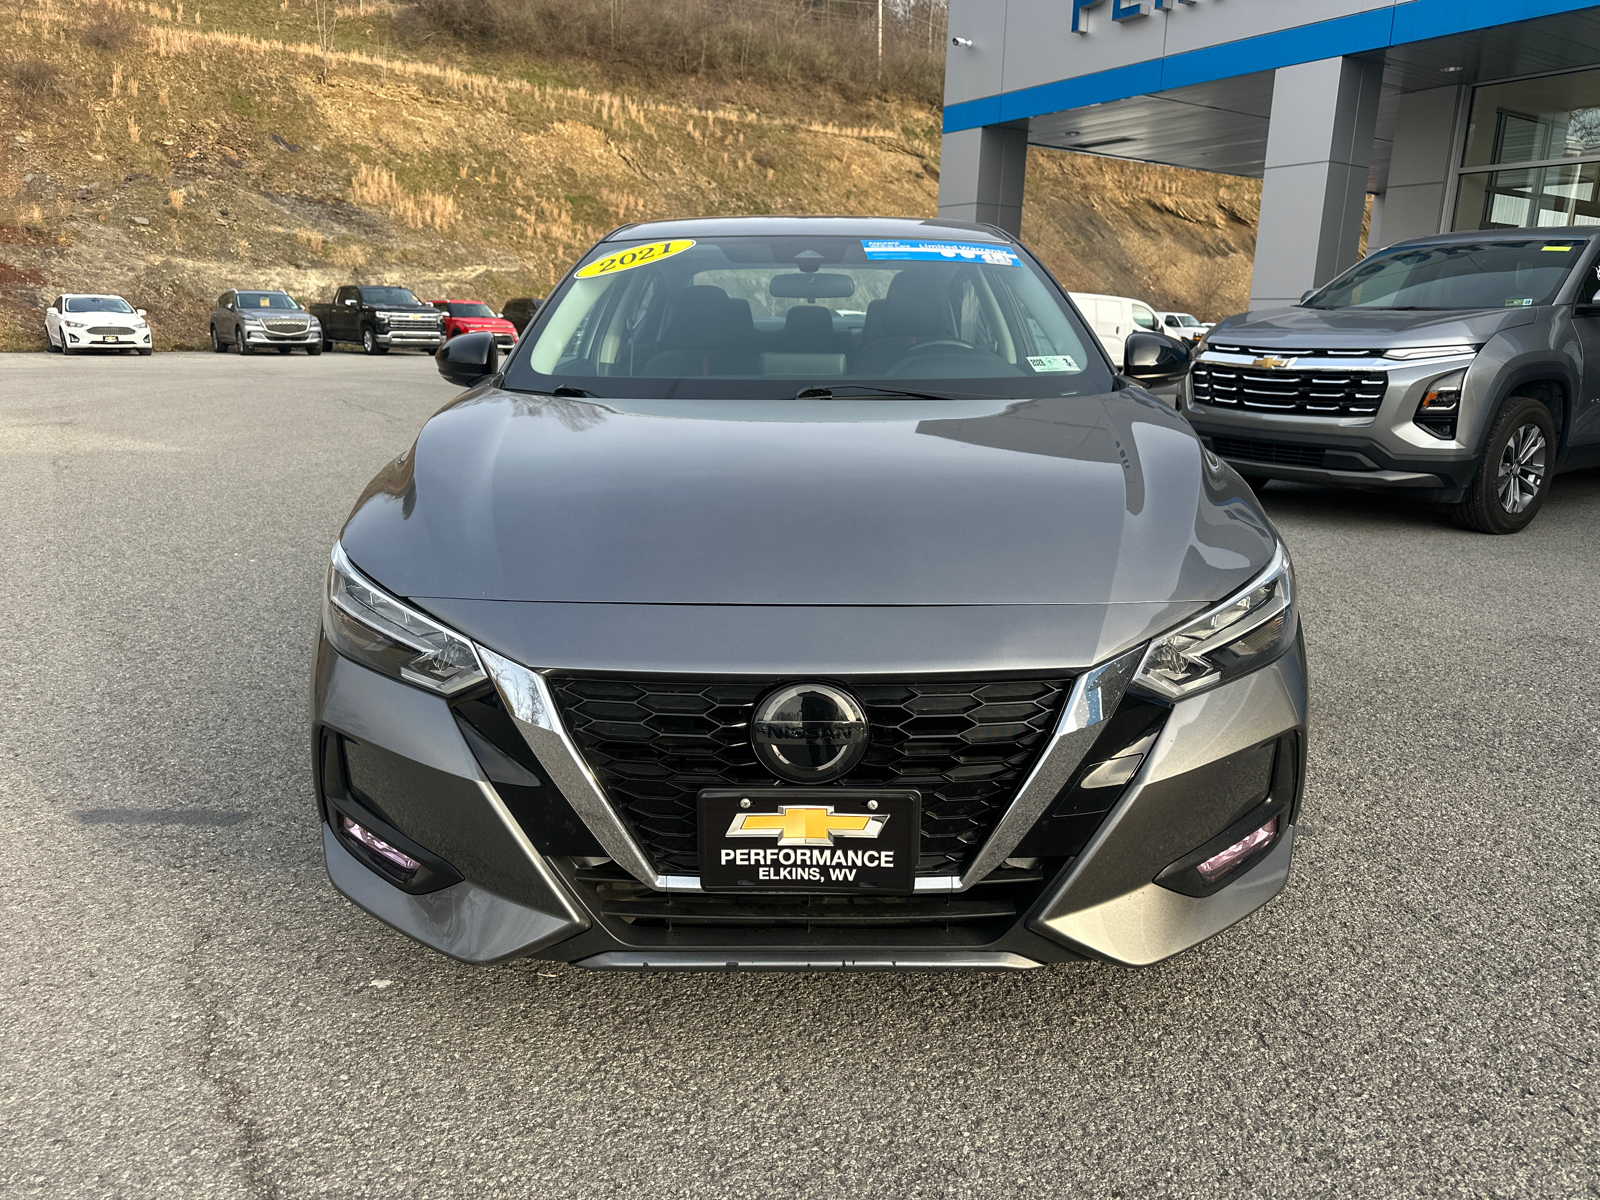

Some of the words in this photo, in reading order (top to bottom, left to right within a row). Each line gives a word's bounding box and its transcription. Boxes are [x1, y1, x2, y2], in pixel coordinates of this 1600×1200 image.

[599, 242, 673, 273] 2021
[959, 245, 1007, 255] Warranty
[767, 725, 853, 740] NISSAN
[720, 849, 895, 868] PERFORMANCE
[758, 867, 825, 883] ELKINS,
[828, 868, 857, 882] WV
